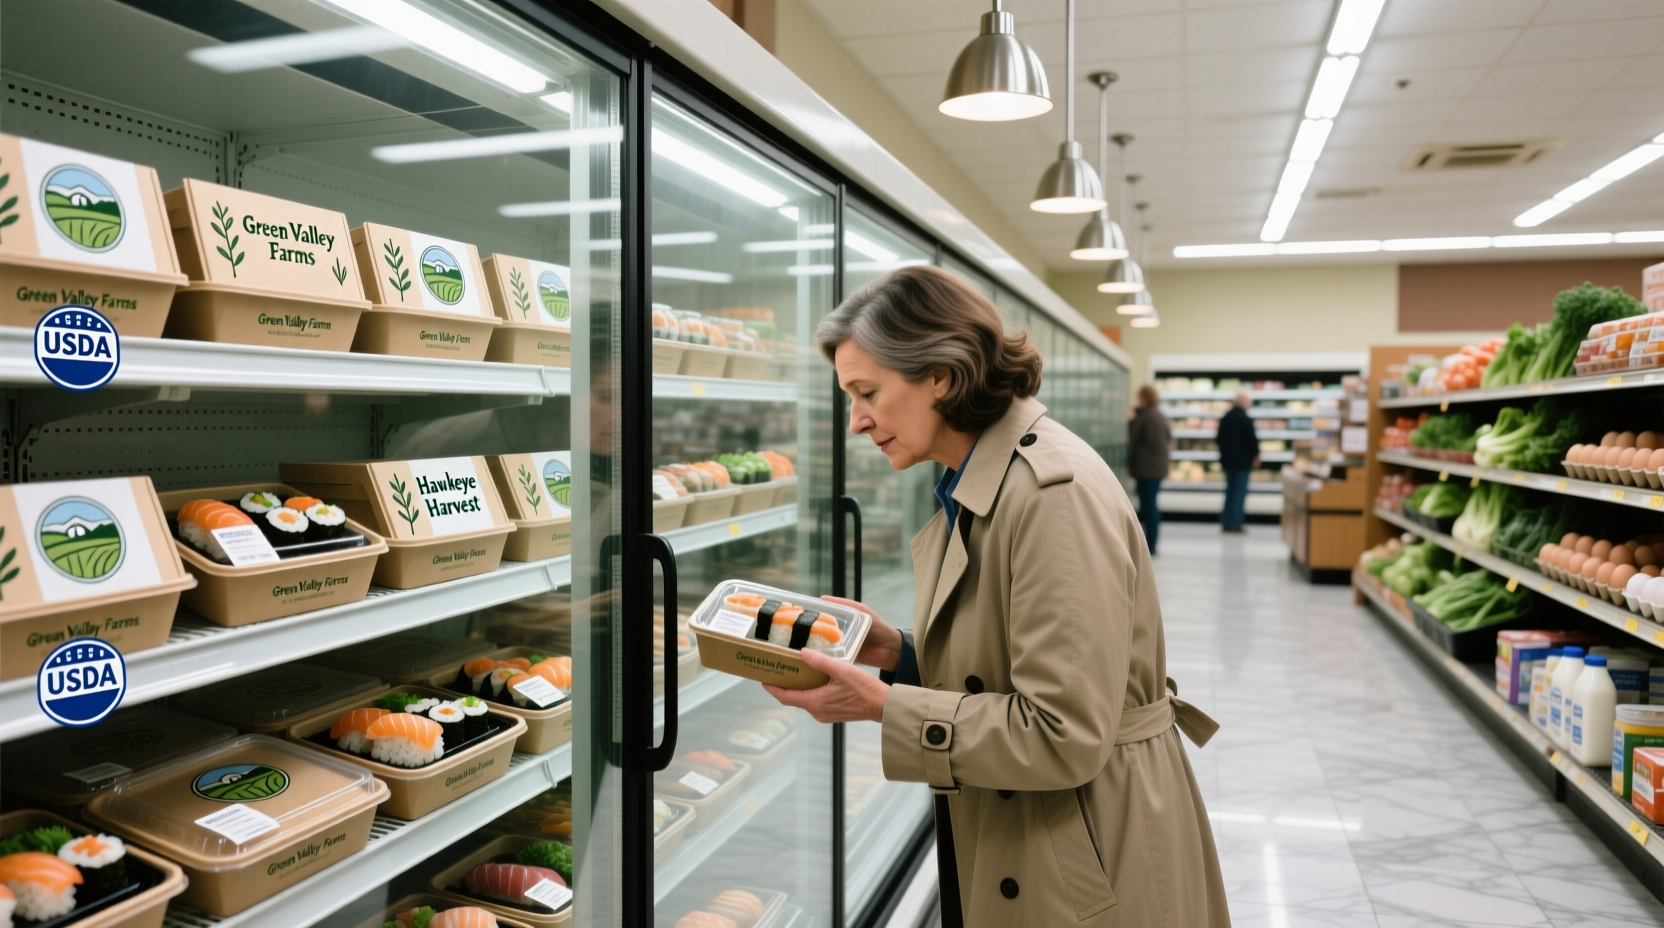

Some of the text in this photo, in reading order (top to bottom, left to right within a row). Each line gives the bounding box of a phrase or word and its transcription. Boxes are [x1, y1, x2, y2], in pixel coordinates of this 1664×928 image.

[243, 214, 335, 252] Green Valley
[267, 241, 316, 266] Farms
[16, 286, 57, 304] Green
[101, 293, 137, 310] Farms
[43, 330, 112, 358] USDA
[415, 471, 477, 495] Hawkeye
[424, 495, 481, 517] Harvest
[104, 616, 140, 632] Farms
[47, 662, 118, 695] USDA
